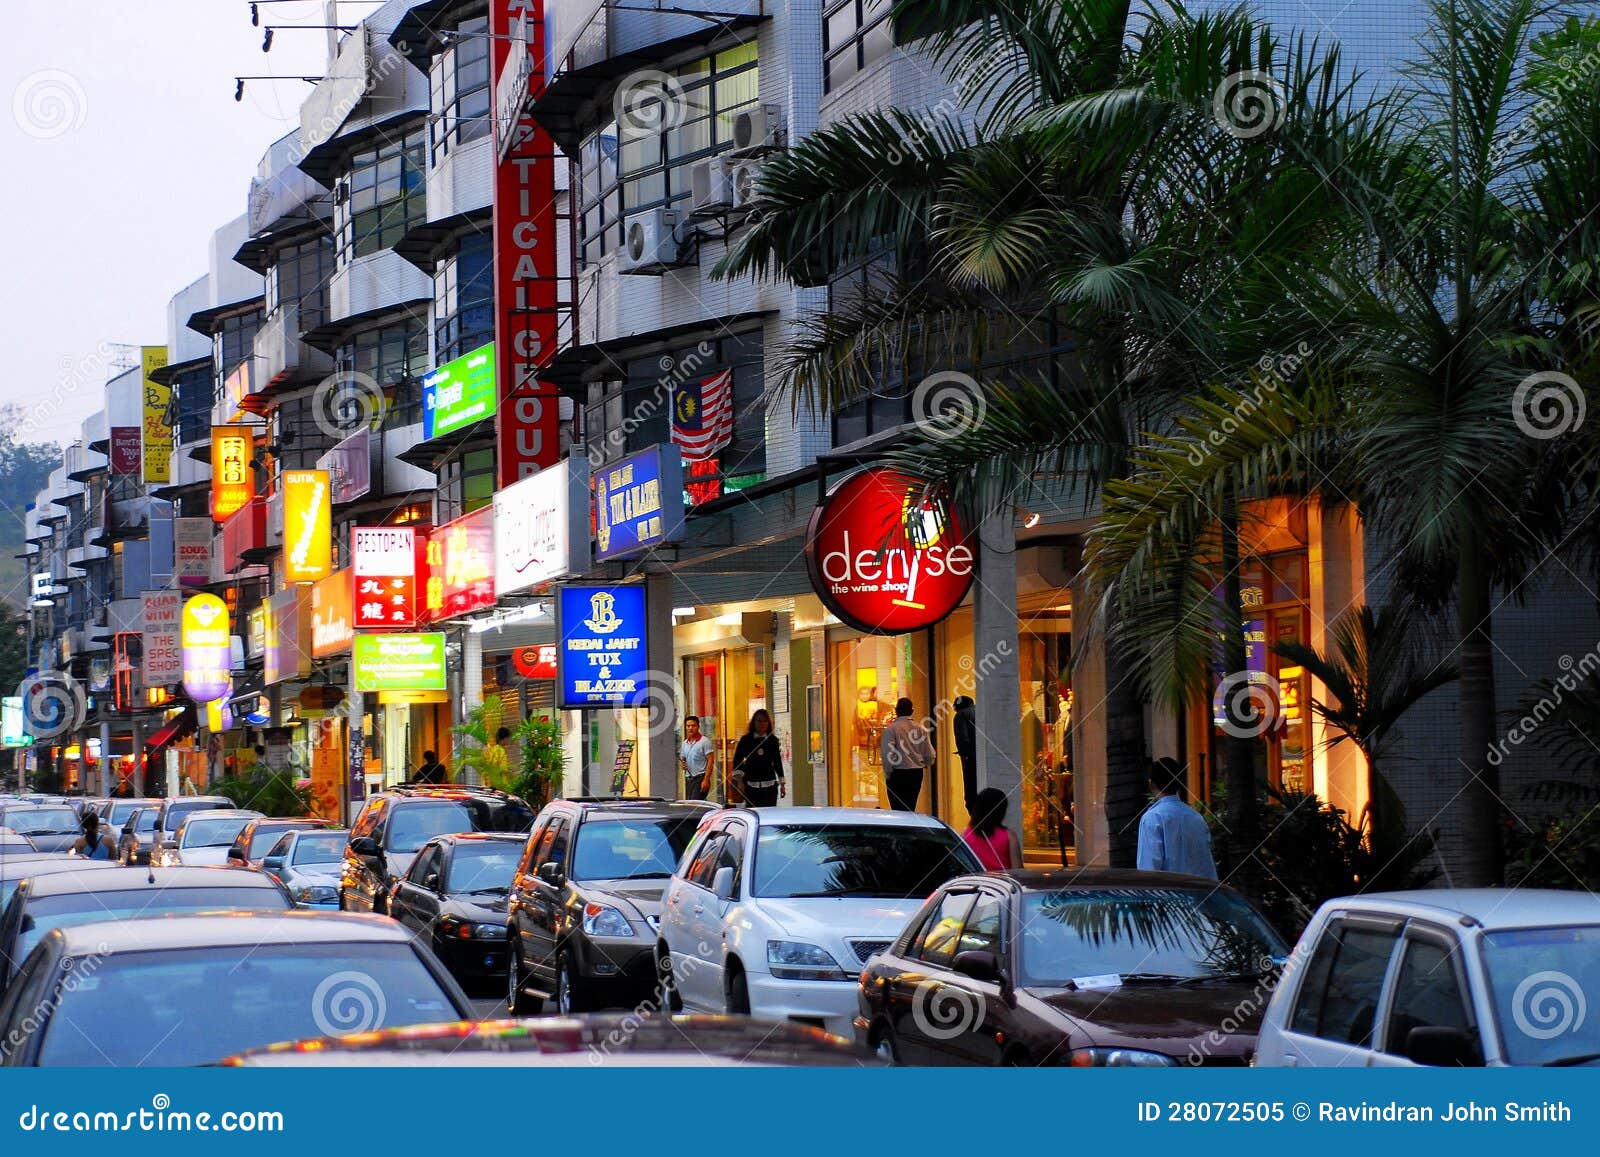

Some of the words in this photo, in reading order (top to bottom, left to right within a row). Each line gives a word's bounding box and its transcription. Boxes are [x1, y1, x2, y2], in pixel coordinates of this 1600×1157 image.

[357, 533, 412, 553] RESTORAN
[832, 583, 849, 594] the
[851, 582, 879, 593] wine
[881, 580, 909, 593] shop
[153, 635, 174, 646] THE
[149, 648, 179, 659] SPEC
[587, 652, 622, 665] TUX
[149, 661, 180, 672] SHOP
[599, 666, 612, 679] &
[574, 680, 636, 693] BLAZER
